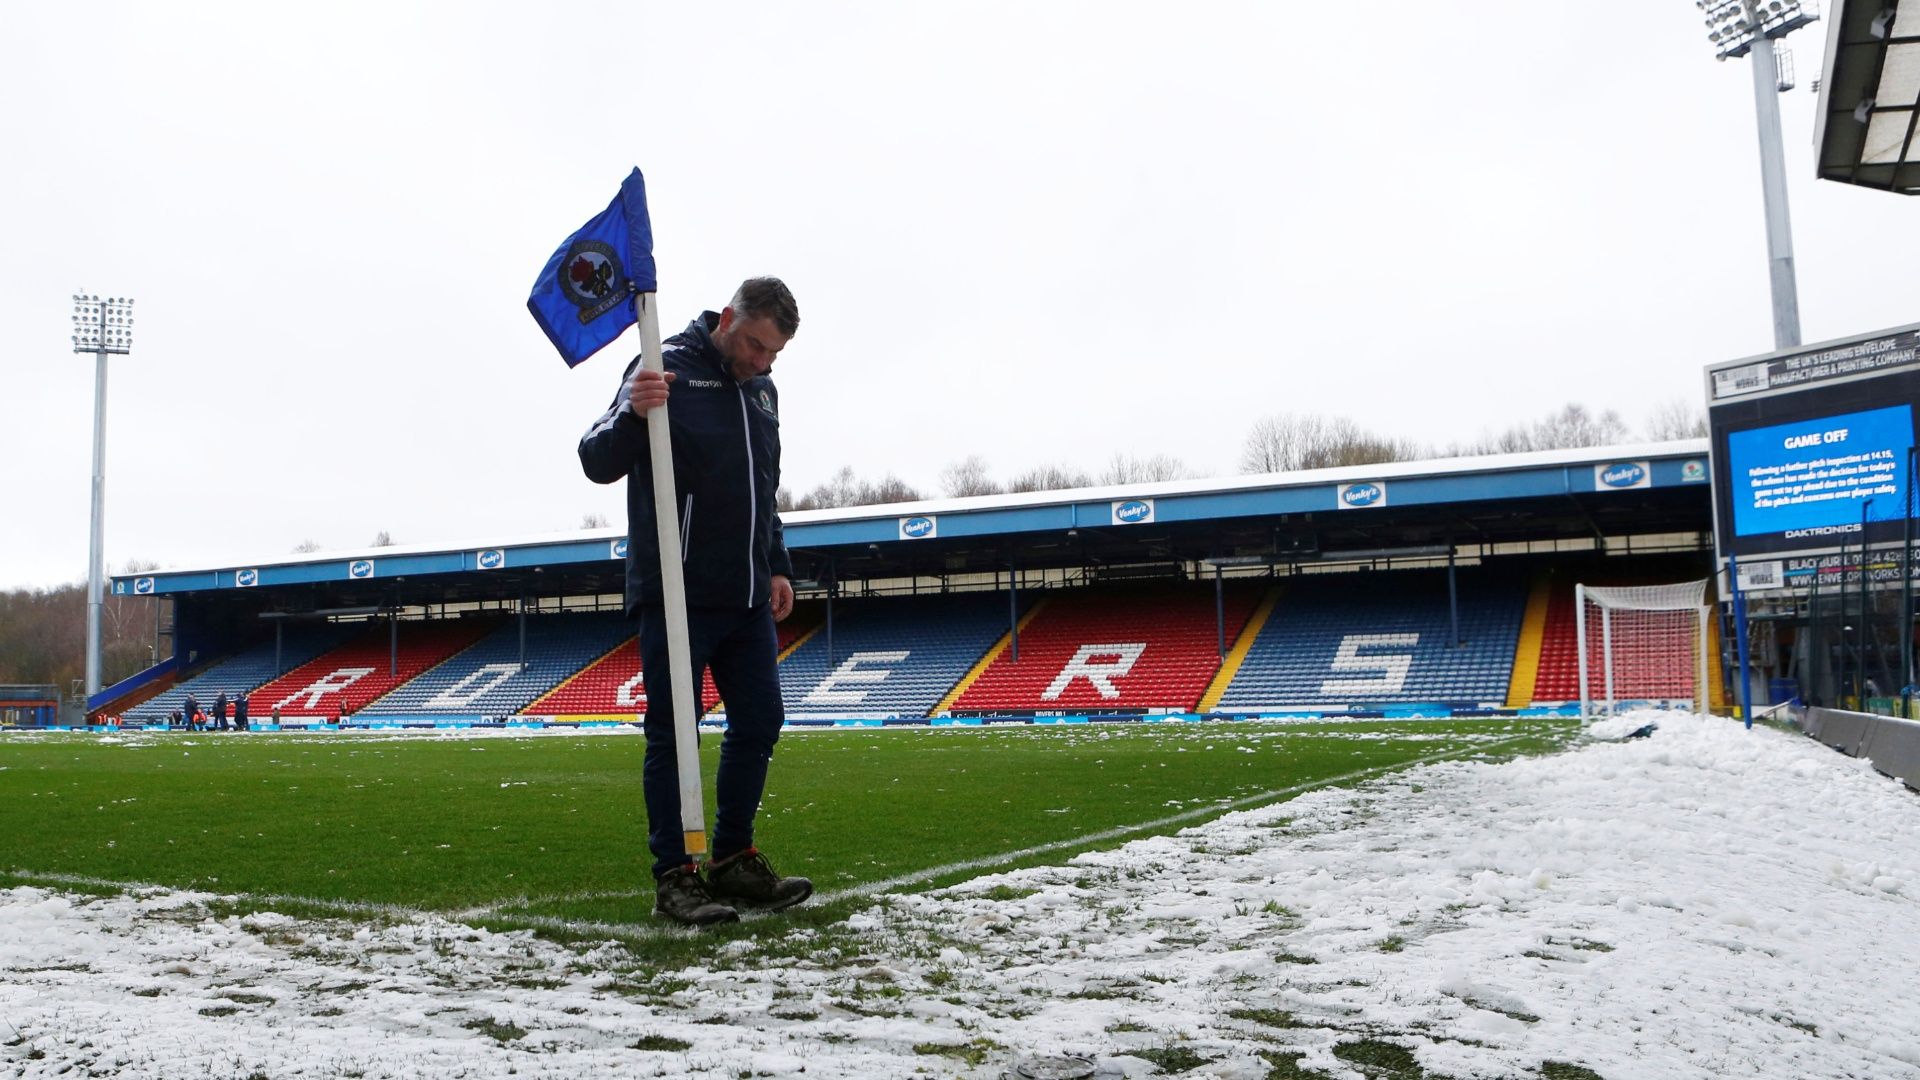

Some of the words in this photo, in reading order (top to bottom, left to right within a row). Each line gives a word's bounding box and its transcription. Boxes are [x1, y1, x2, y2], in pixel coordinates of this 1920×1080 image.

[1785, 357, 1800, 370] THE
[1801, 353, 1820, 367] UK'S
[1820, 347, 1854, 364] LEADING
[1854, 339, 1897, 357] ENVELOPE
[1769, 364, 1831, 386] MANUFACTURER
[1838, 356, 1875, 374] PRINTING
[1875, 349, 1916, 366] COMPANY
[688, 379, 722, 388] macron
[1784, 432, 1822, 450] GAME
[1823, 428, 1849, 444] OFF
[1825, 454, 1862, 467] inspection
[1603, 467, 1640, 483] Venky's
[1797, 470, 1817, 481] made
[1816, 469, 1829, 479] the
[1829, 466, 1858, 477] decision
[1858, 464, 1869, 474] for
[1869, 461, 1896, 473] today's
[1346, 487, 1377, 502] Venky's
[1754, 489, 1773, 500] game
[1846, 476, 1859, 486] the
[1859, 473, 1894, 485] condition
[1773, 495, 1791, 509] pitch
[1790, 493, 1804, 505] and
[1851, 487, 1874, 500] player
[1119, 504, 1147, 519] Venky's
[905, 521, 930, 533] Venky's
[1785, 523, 1863, 539] DAKTRONICS
[1040, 642, 1147, 701] R
[1320, 632, 1419, 695] S
